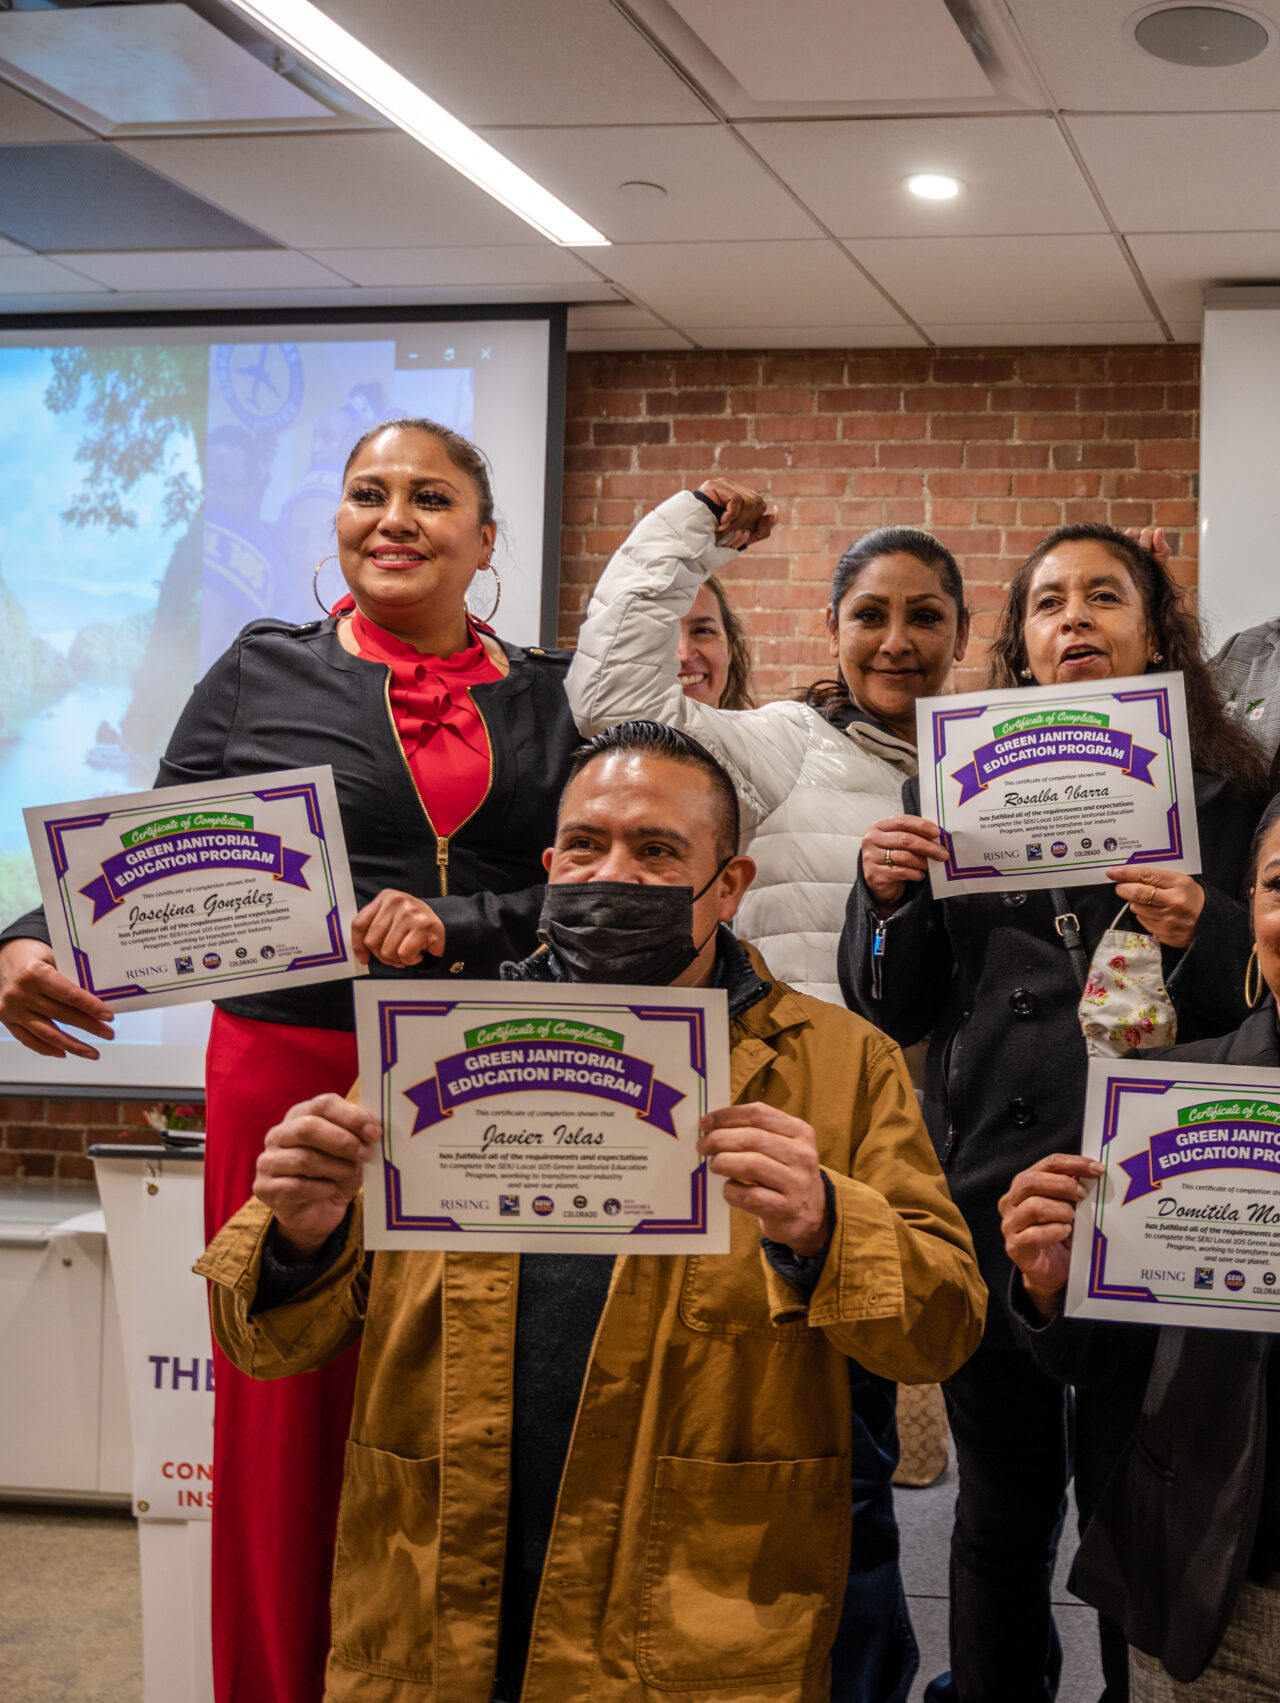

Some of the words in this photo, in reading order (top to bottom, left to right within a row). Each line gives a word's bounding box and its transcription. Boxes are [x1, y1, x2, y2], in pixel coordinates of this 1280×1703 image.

[1002, 715, 1044, 734] Certificate
[1045, 713, 1054, 724] of
[1057, 712, 1102, 725] Completion
[995, 734, 1037, 754] GREEN
[1039, 731, 1111, 743] JANITORIAL
[983, 745, 1056, 773] EDUCATION
[1059, 744, 1124, 759] PROGRAM
[1004, 788, 1058, 806] Rosalba
[1065, 785, 1109, 800] Ibarra
[132, 820, 179, 843] Certificate
[180, 816, 190, 828] of
[194, 814, 246, 827] Completion
[126, 842, 174, 865] GREEN
[177, 835, 258, 851] JANITORIAL
[983, 849, 1019, 861] RISING
[1074, 848, 1100, 857] COLORADO
[115, 852, 198, 886] EDUCATION
[200, 849, 274, 864] PROGRAM
[130, 903, 195, 930] Josefina
[204, 889, 272, 917] González
[125, 963, 168, 979] RISING
[228, 957, 257, 967] COLORADO
[477, 1023, 535, 1044] Certificate
[537, 1022, 550, 1037] of
[553, 1022, 614, 1046] Completion
[465, 1050, 524, 1070] GREEN
[527, 1049, 625, 1073] JANITORIAL
[448, 1068, 549, 1096] EDUCATION
[553, 1068, 642, 1097] PROGRAM
[1189, 1104, 1240, 1122] Certificate
[1242, 1104, 1254, 1118] of
[481, 1124, 542, 1152] Javier
[553, 1124, 603, 1145] Islas
[1176, 1129, 1228, 1146] GREEN
[1158, 1146, 1250, 1168] EDUCATION
[1195, 1183, 1226, 1191] certificate
[1227, 1185, 1235, 1193] of
[1235, 1186, 1270, 1196] completion
[440, 1199, 489, 1209] RISING
[1158, 1198, 1240, 1221] Domitila
[1153, 1233, 1183, 1241] complete
[1159, 1223, 1187, 1232] fulfilled
[1199, 1226, 1207, 1234] of
[1222, 1227, 1271, 1238] requirements
[1166, 1243, 1197, 1251] Program,
[1198, 1245, 1225, 1253] working
[1235, 1248, 1268, 1256] transform
[1140, 1269, 1185, 1281] RISING
